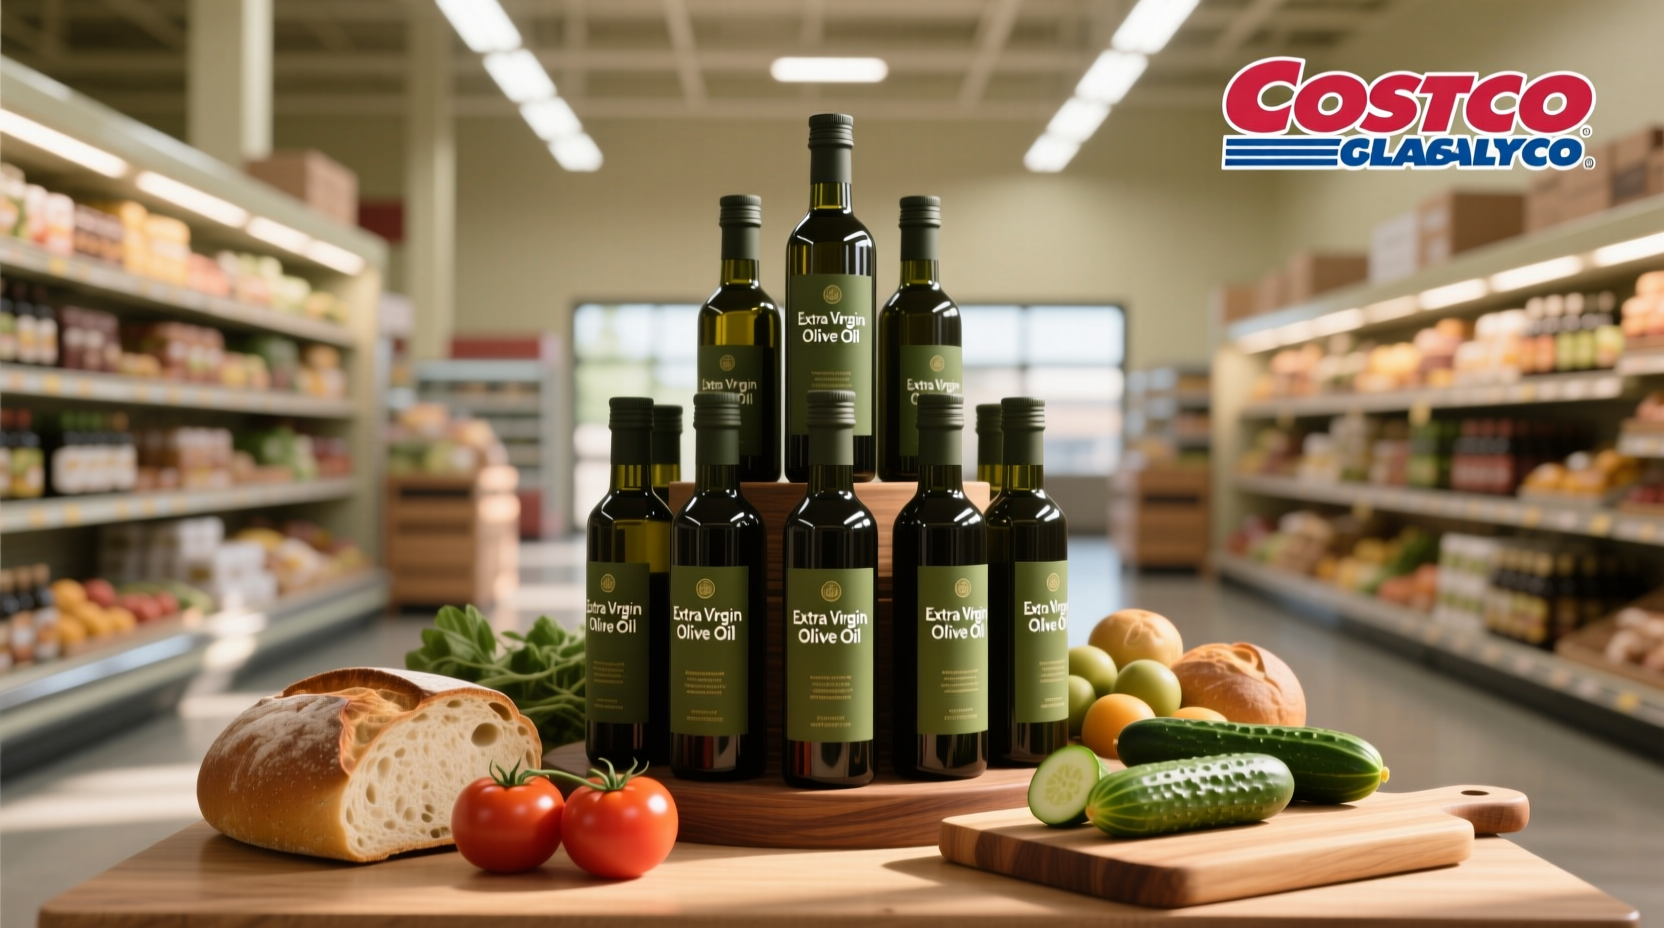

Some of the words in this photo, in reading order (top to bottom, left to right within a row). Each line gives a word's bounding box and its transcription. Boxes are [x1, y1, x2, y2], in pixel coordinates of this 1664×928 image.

[798, 312, 828, 325] Extra
[802, 329, 838, 343] Olive
[793, 610, 827, 625] Extra
[830, 610, 868, 629] Virgin
[926, 607, 960, 621] Extra
[677, 624, 711, 640] Olive
[714, 624, 736, 641] Oil
[798, 628, 838, 644] Olive
[840, 628, 861, 644] Oil
[932, 624, 968, 640] Olive
